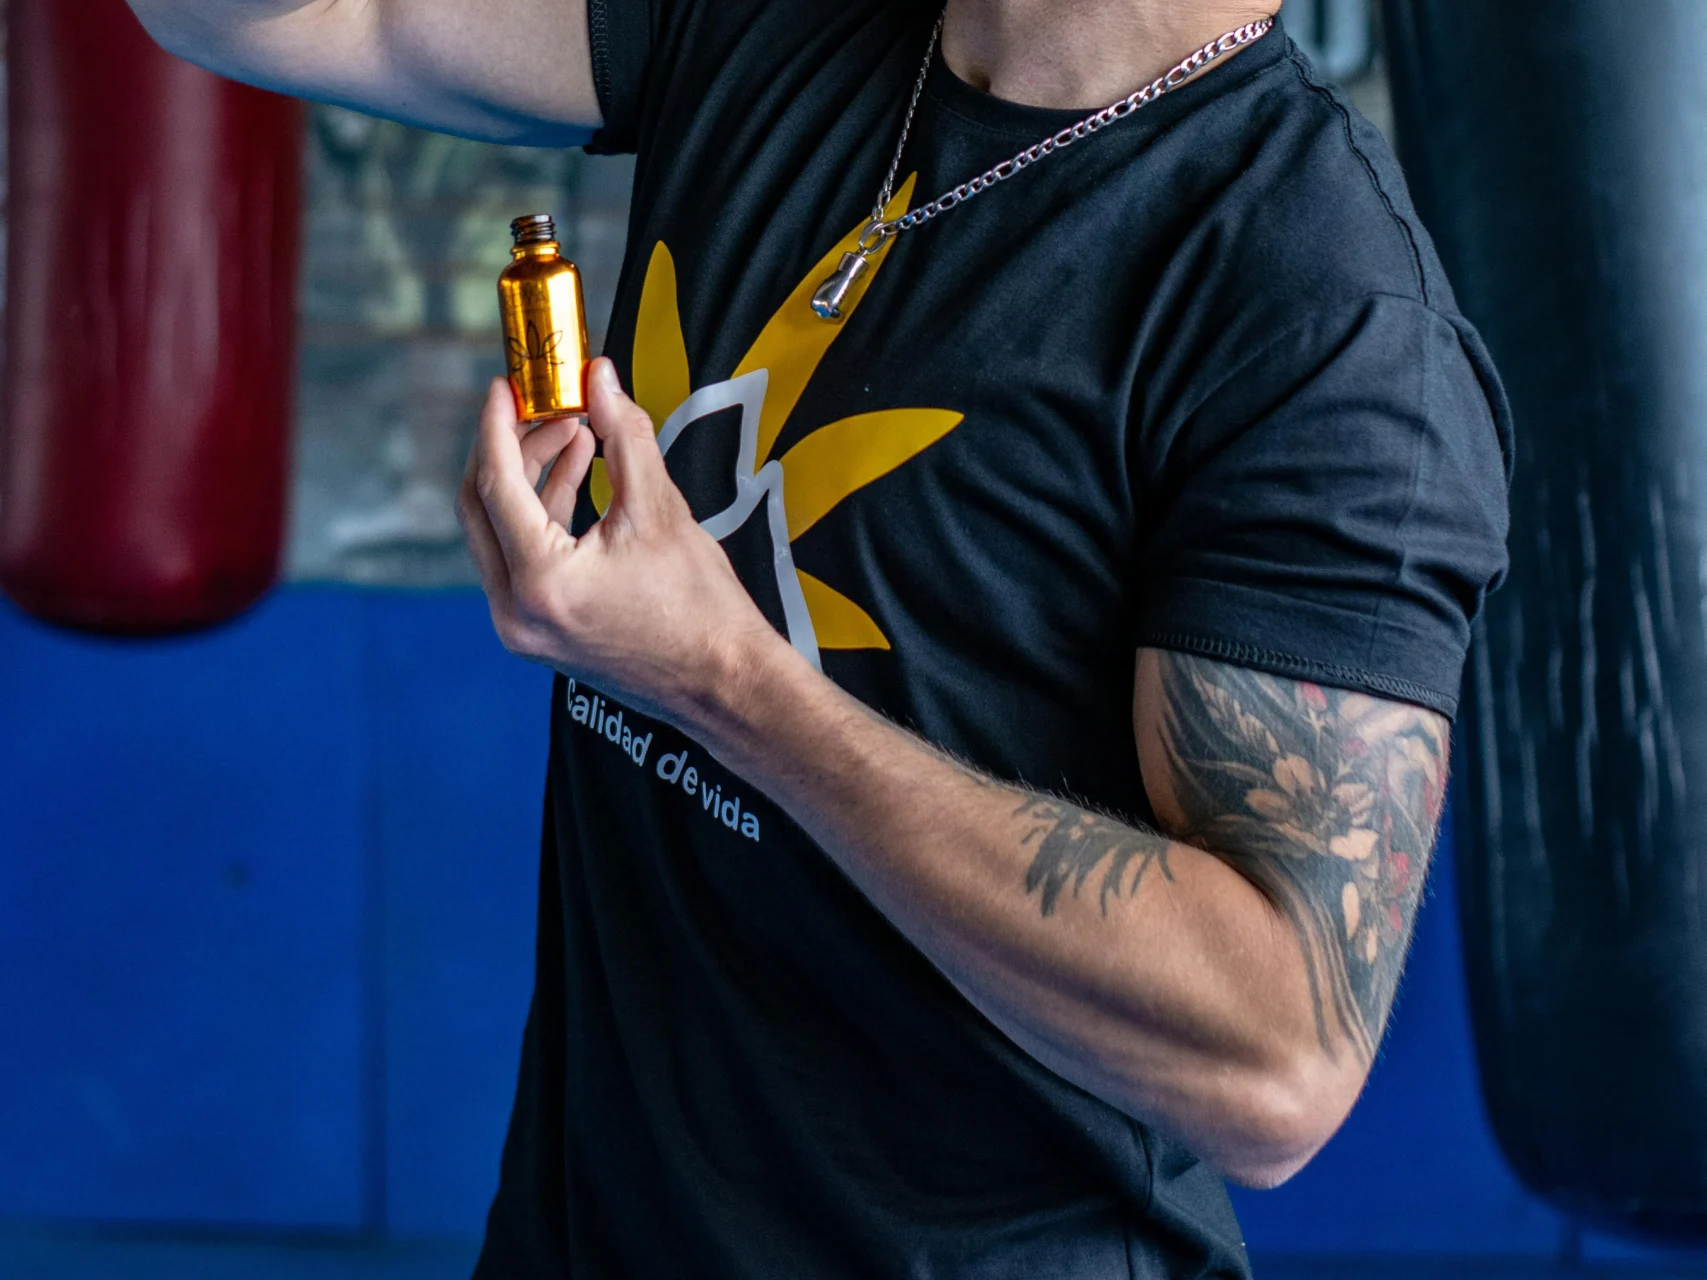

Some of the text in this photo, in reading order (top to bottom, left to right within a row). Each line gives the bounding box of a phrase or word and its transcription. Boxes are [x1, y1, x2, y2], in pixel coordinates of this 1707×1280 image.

[566, 677, 760, 843] Calidad de vida
